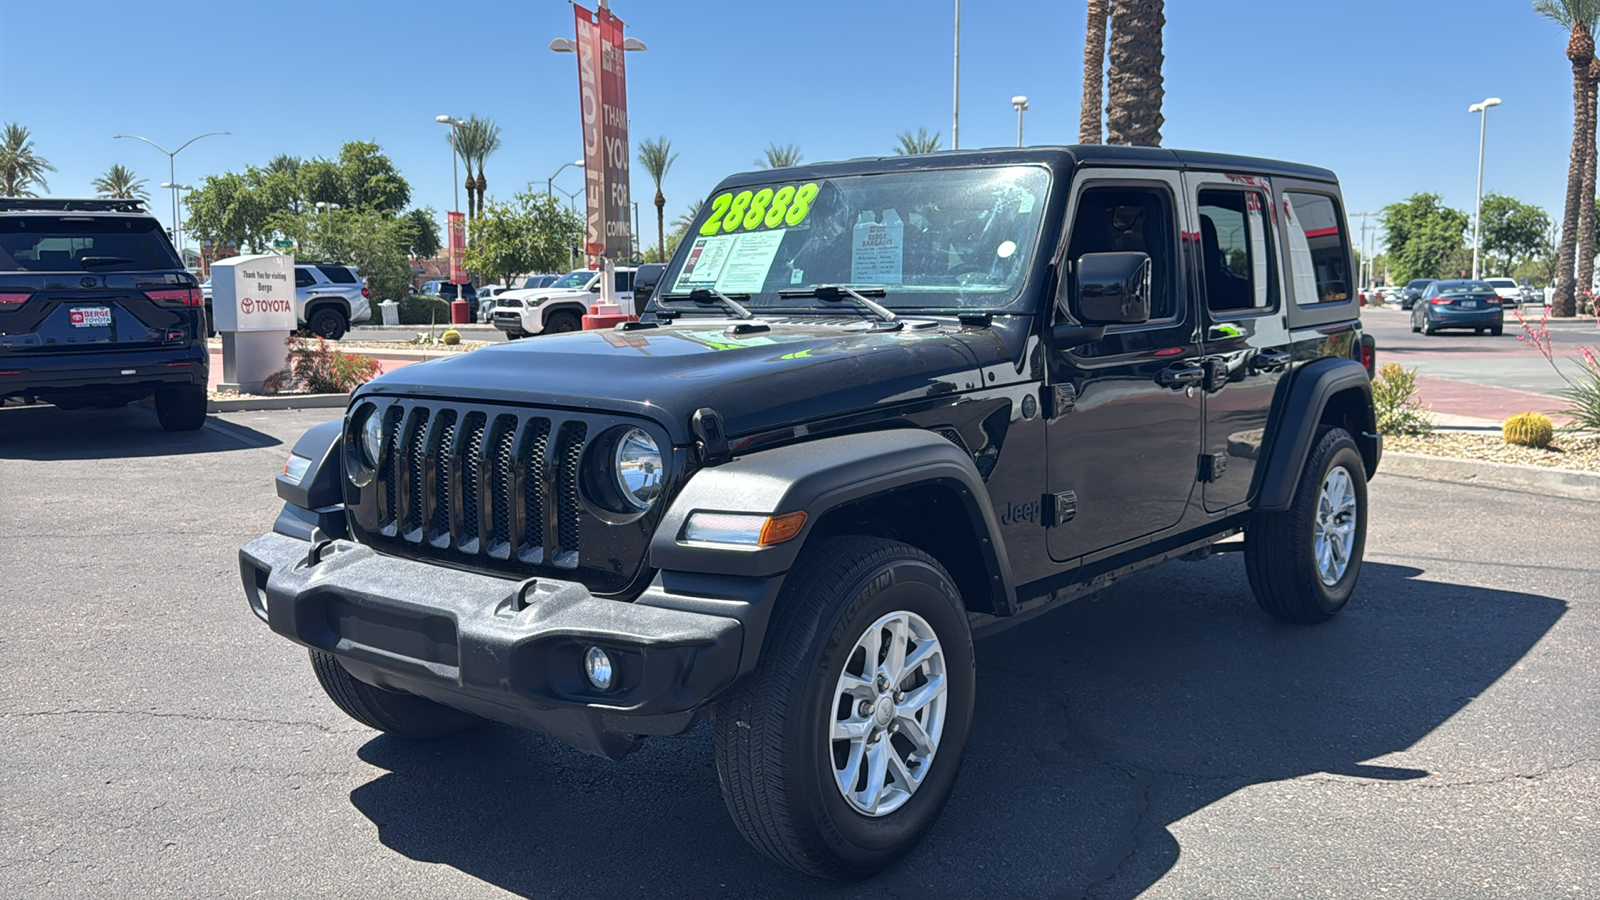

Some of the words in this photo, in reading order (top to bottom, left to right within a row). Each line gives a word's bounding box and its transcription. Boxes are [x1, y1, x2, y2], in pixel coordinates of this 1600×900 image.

[603, 104, 627, 130] THANK
[605, 136, 628, 171] YOU
[611, 183, 628, 207] FOR
[699, 182, 818, 236] 28888
[862, 239, 893, 247] BARGAINS
[243, 270, 255, 279] Thank
[271, 272, 286, 281] visiting
[258, 282, 272, 293] Berge
[255, 300, 291, 312] TOYOTA
[1002, 501, 1040, 525] Jeep
[832, 570, 892, 644] MICHELIN
